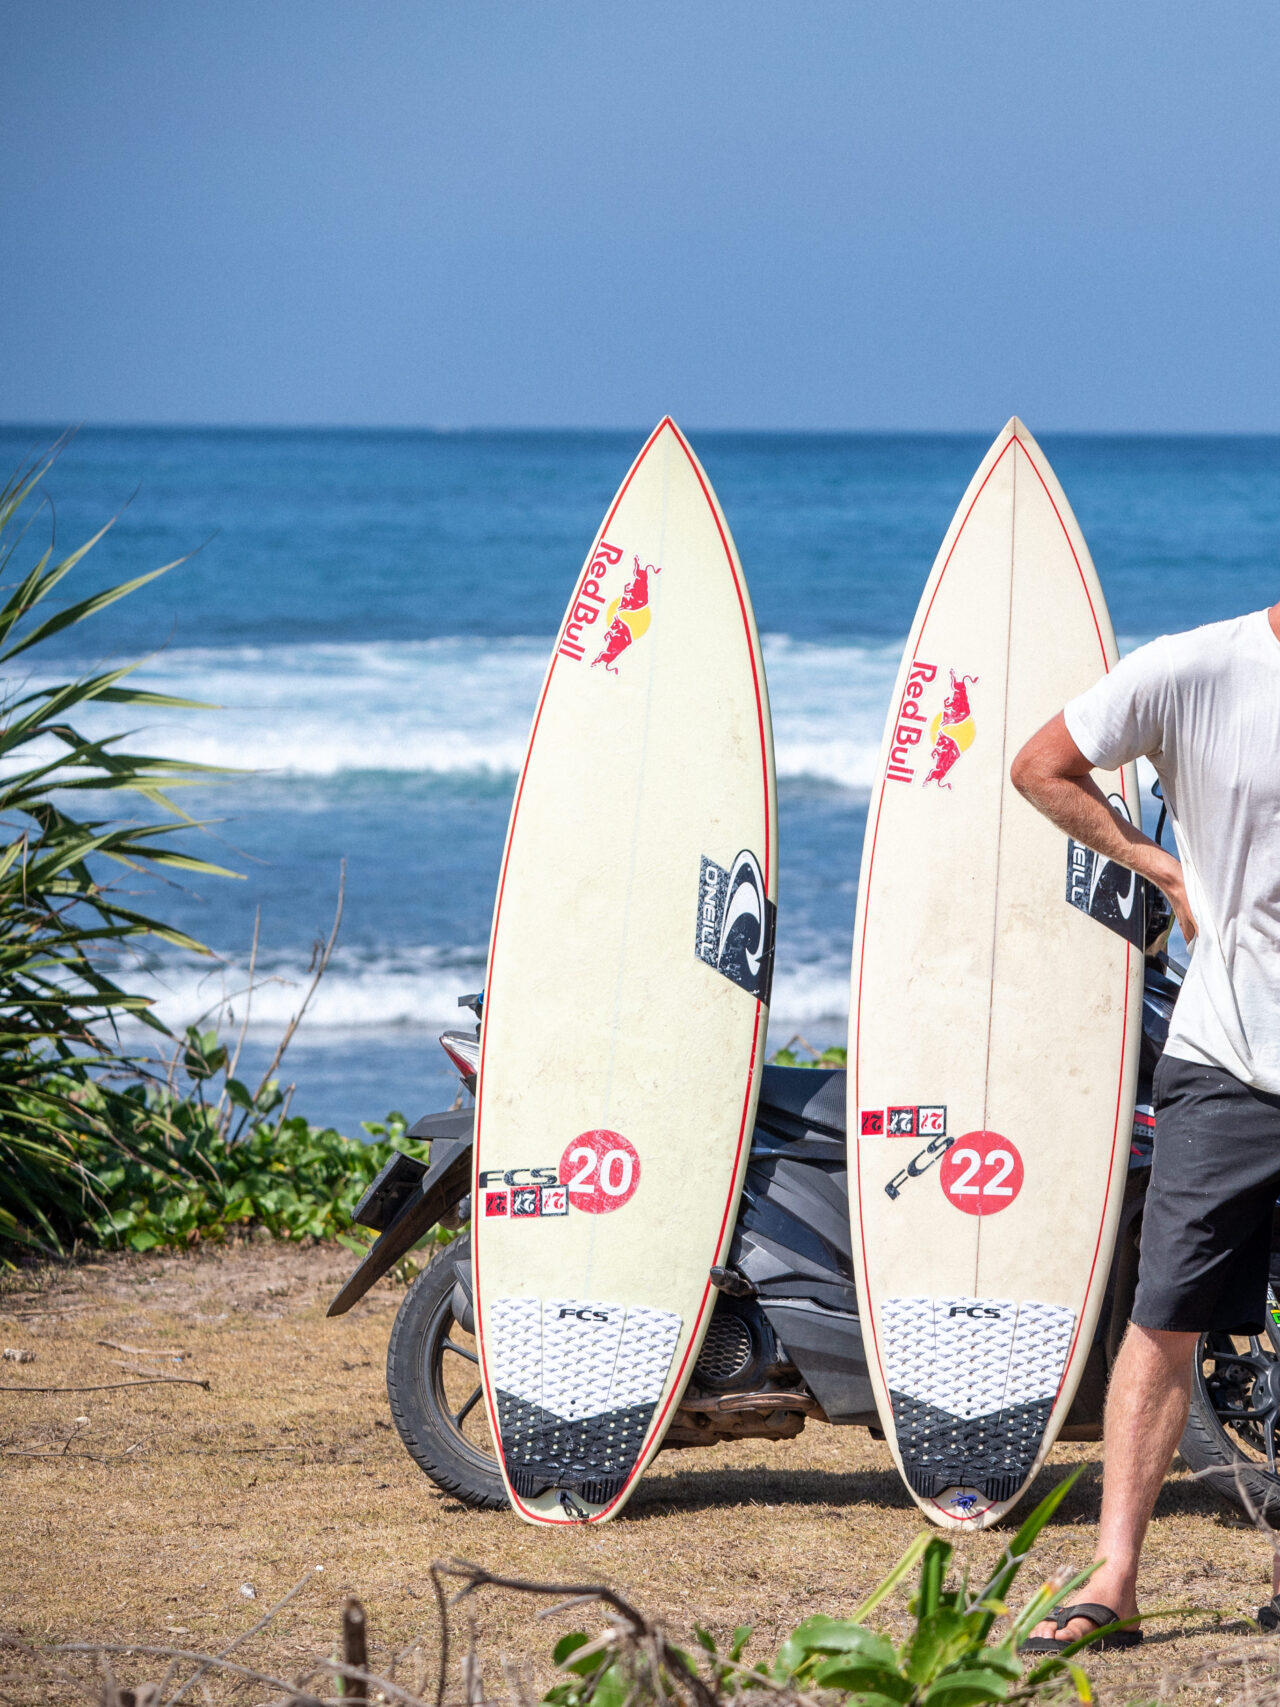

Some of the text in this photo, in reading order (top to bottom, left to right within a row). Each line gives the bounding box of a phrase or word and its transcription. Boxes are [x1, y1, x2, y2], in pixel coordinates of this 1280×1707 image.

[559, 541, 623, 661] Red Bull
[886, 661, 938, 783] Red Bull
[478, 1167, 557, 1188] FCS
[568, 1147, 632, 1197] 20
[885, 1135, 955, 1200] FCS
[950, 1148, 1014, 1196] 22
[558, 1308, 609, 1322] FCS
[949, 1306, 1000, 1319] FCS
